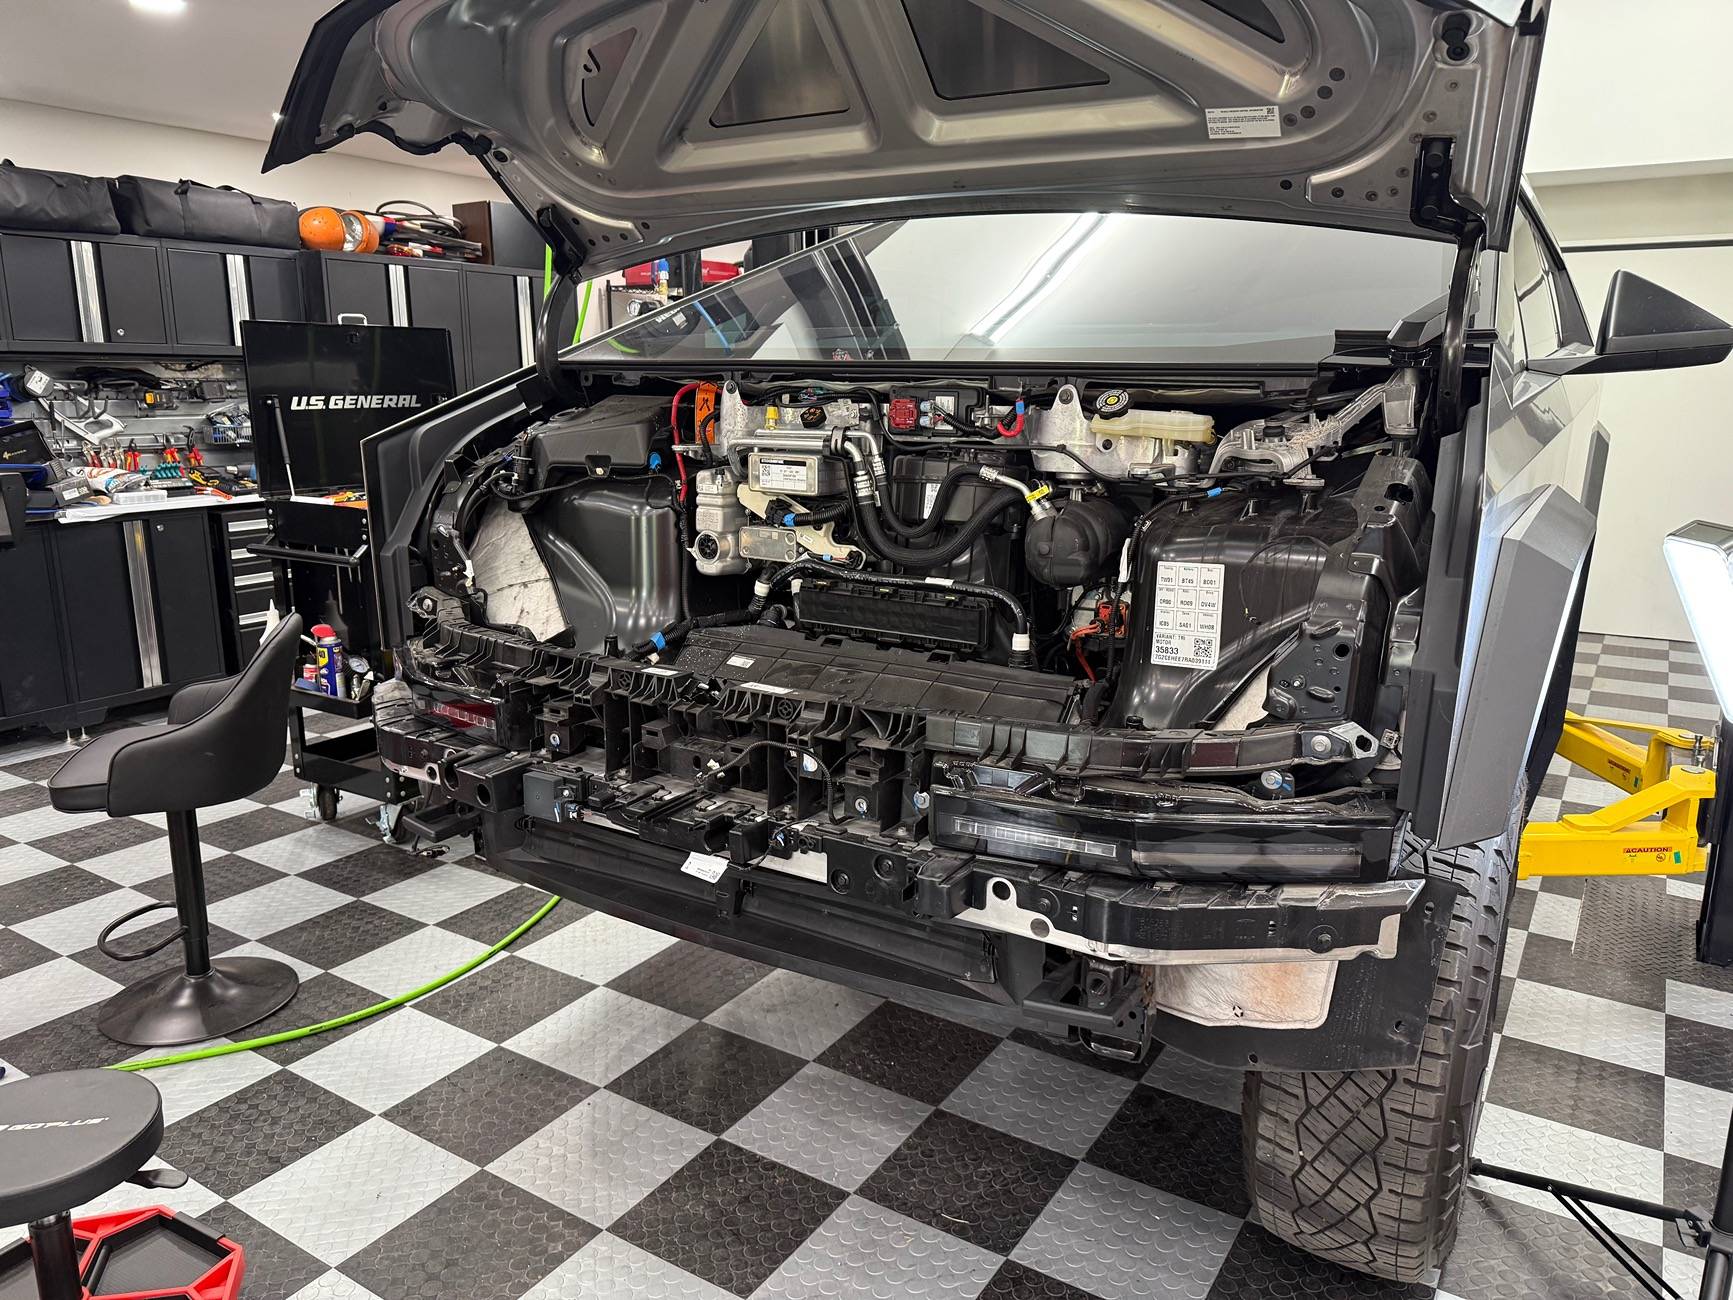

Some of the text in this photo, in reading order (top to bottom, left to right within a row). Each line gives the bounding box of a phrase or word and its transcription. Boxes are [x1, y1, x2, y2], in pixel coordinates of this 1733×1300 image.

[290, 395, 422, 411] U.S. GENERAL
[1155, 638, 1171, 646] MOTOR
[1155, 645, 1179, 655] 35833
